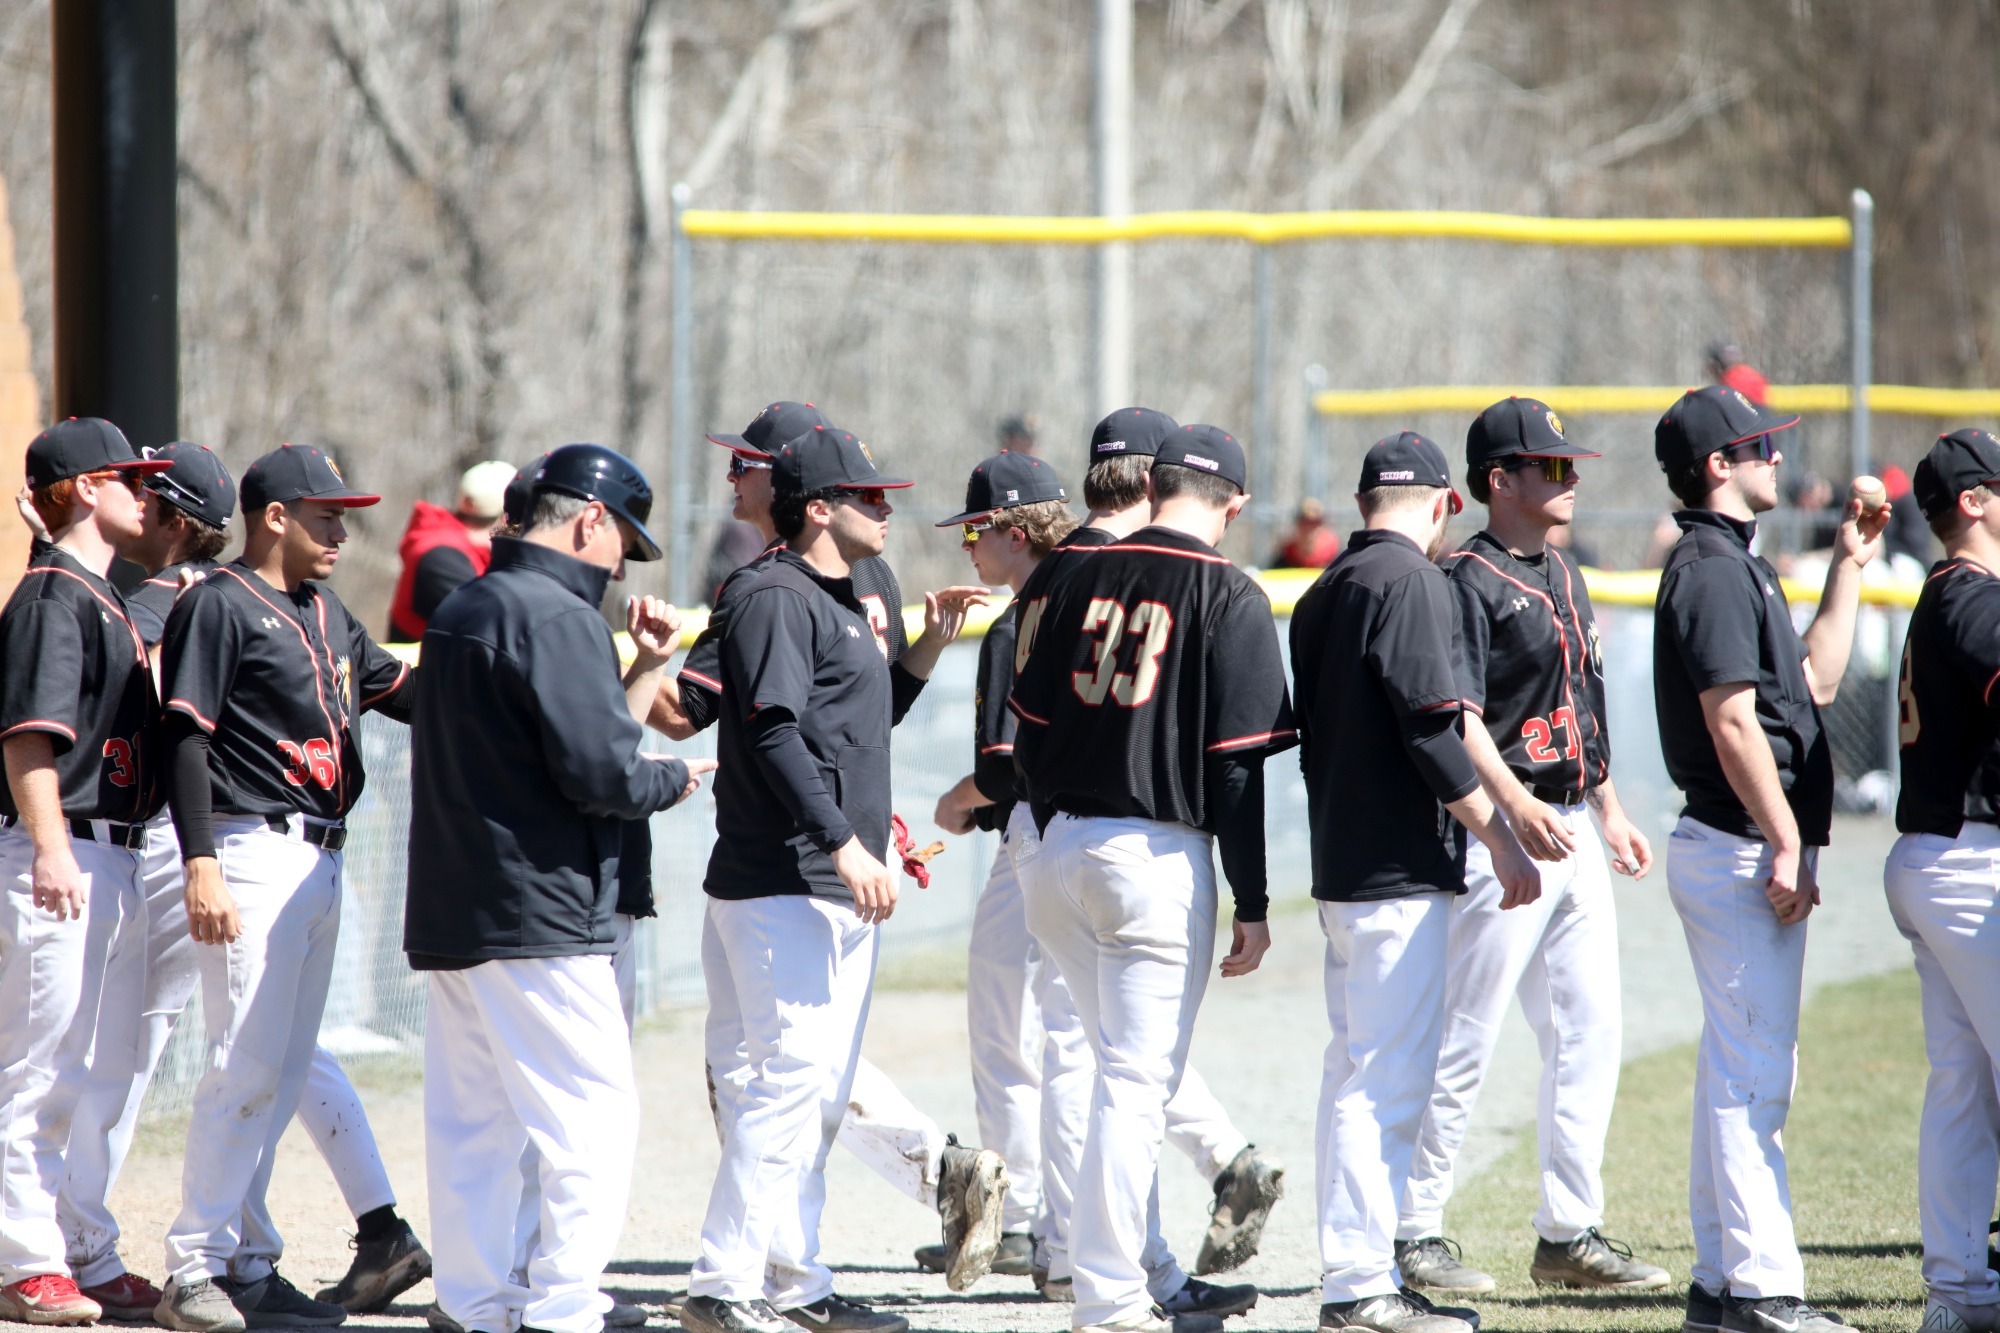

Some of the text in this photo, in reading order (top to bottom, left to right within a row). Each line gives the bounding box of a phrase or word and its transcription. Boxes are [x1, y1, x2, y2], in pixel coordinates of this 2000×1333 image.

[1072, 597, 1173, 708] 33
[102, 731, 142, 788] 3
[1521, 705, 1579, 763] 27
[276, 737, 336, 791] 36
